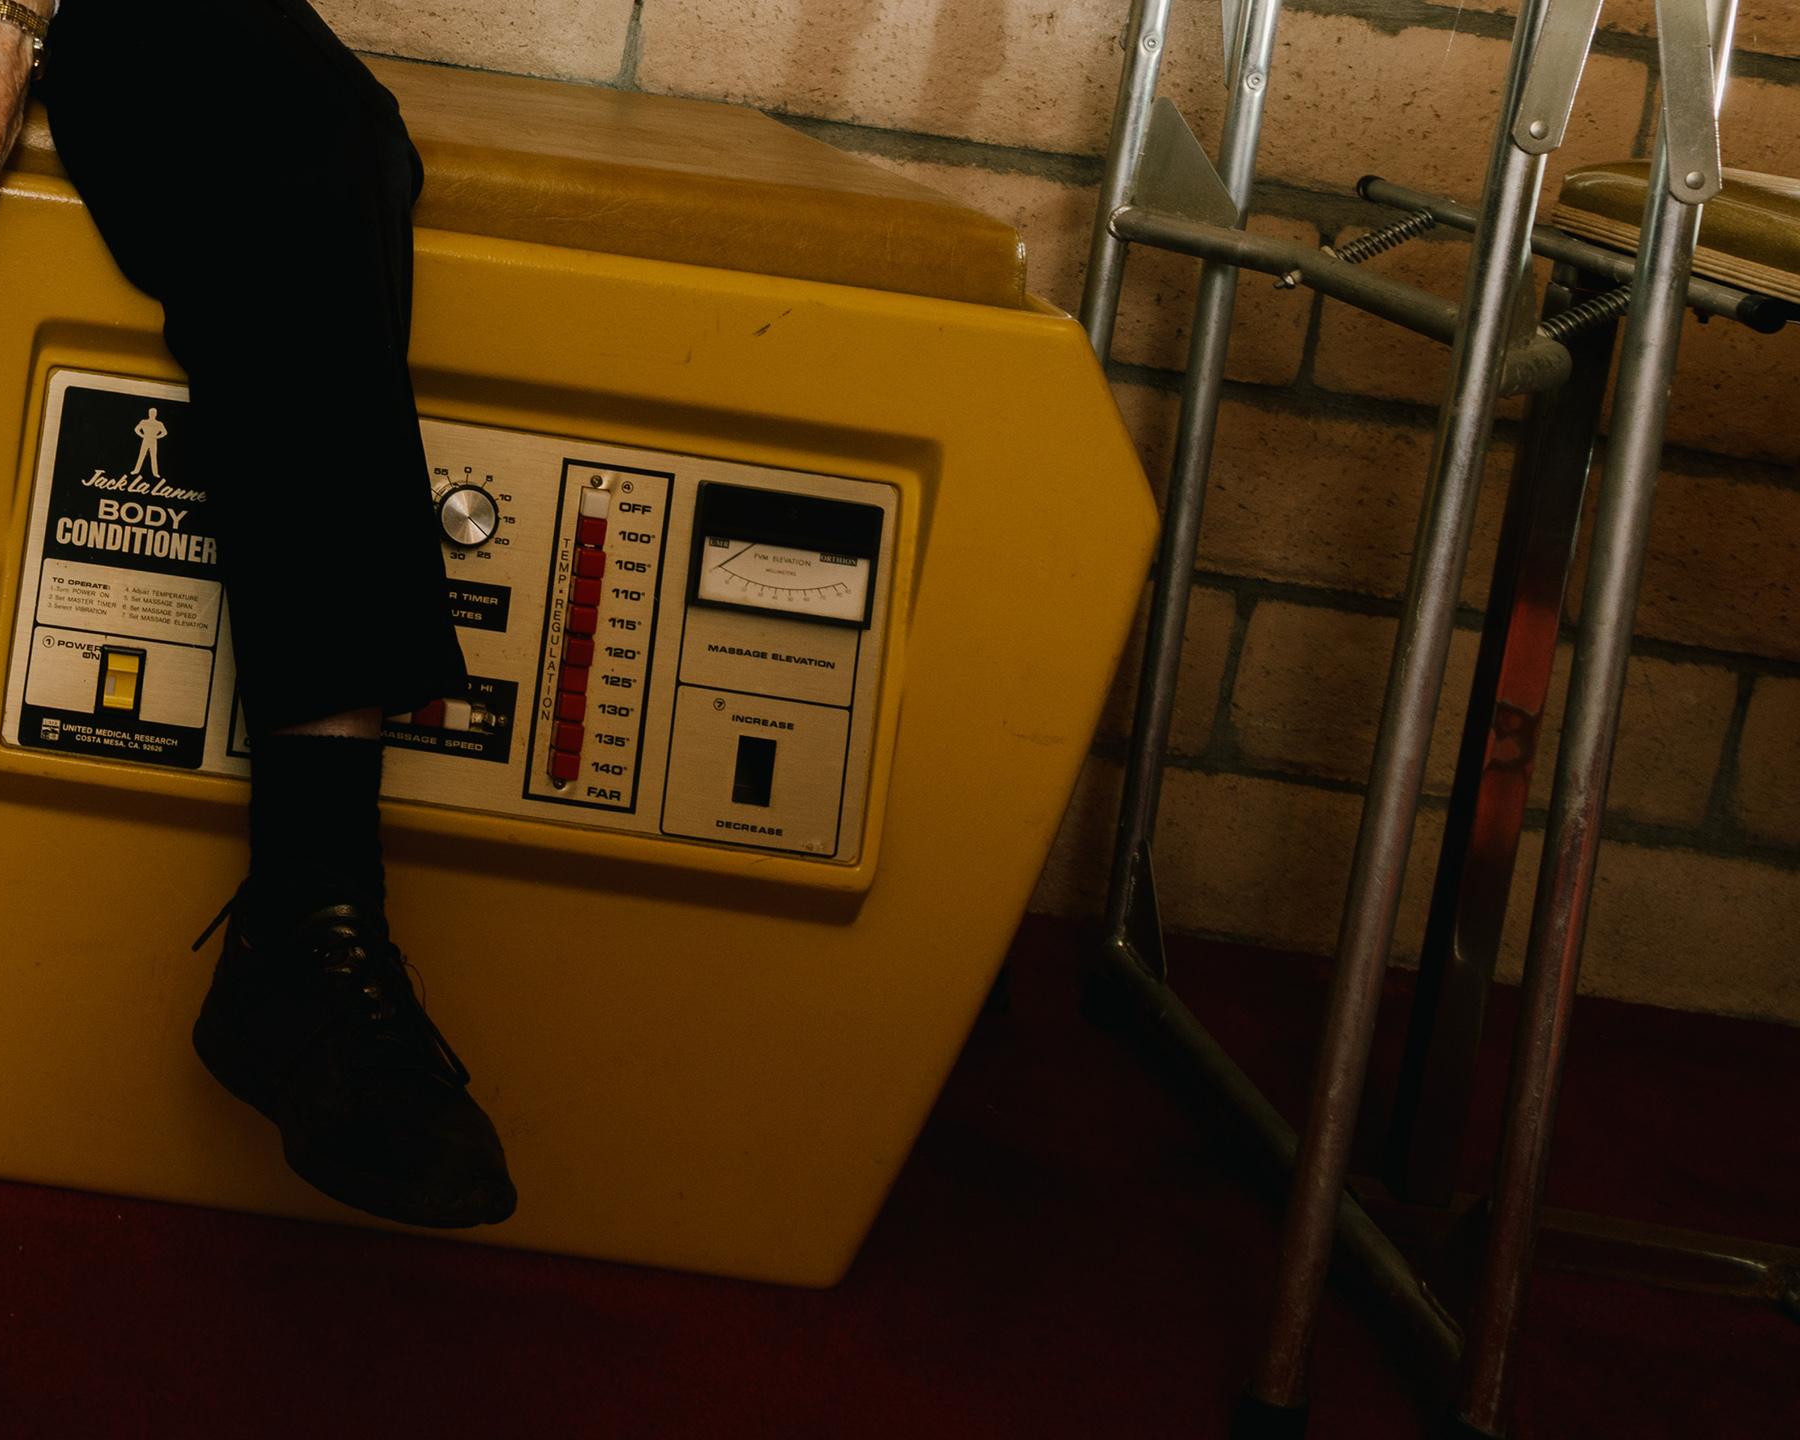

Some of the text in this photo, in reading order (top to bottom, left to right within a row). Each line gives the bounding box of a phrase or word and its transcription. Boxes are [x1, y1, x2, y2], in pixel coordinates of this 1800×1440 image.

[434, 468, 448, 476] 55
[82, 469, 128, 491] Jack
[499, 494, 512, 502] 10
[98, 499, 188, 529] BODY
[619, 502, 652, 515] OFF
[503, 516, 515, 524] 15
[56, 517, 217, 564] CONDITIONER
[450, 552, 466, 560] 30
[477, 550, 491, 559] 25
[772, 556, 811, 566] ELEVATION
[72, 588, 96, 597] POWER
[152, 589, 198, 602] TEMPERATURE
[67, 596, 93, 606] MASTER
[97, 599, 117, 608] TIMER
[142, 597, 172, 607] MASSAGE
[176, 602, 193, 610] SPAN
[462, 593, 498, 605] TIMER
[75, 605, 108, 616] VIBRATION
[142, 605, 172, 616] MASSAGE
[176, 610, 197, 619] SPEED
[451, 610, 482, 620] UTES
[140, 614, 171, 625] MASSAGE
[173, 618, 208, 629] ELEVATION
[541, 538, 571, 720] TEMP REGULATION
[57, 640, 101, 652] POWER
[708, 644, 836, 669] MASSAGE ELEVATION
[481, 684, 493, 692] HI
[732, 714, 794, 730] INCREASE
[62, 724, 178, 746] UNITED MEDICAL RESEARCH
[75, 734, 101, 744] COSTA
[445, 739, 483, 751] SPEED
[587, 787, 621, 801] FAR
[716, 820, 783, 836] DECREASE
